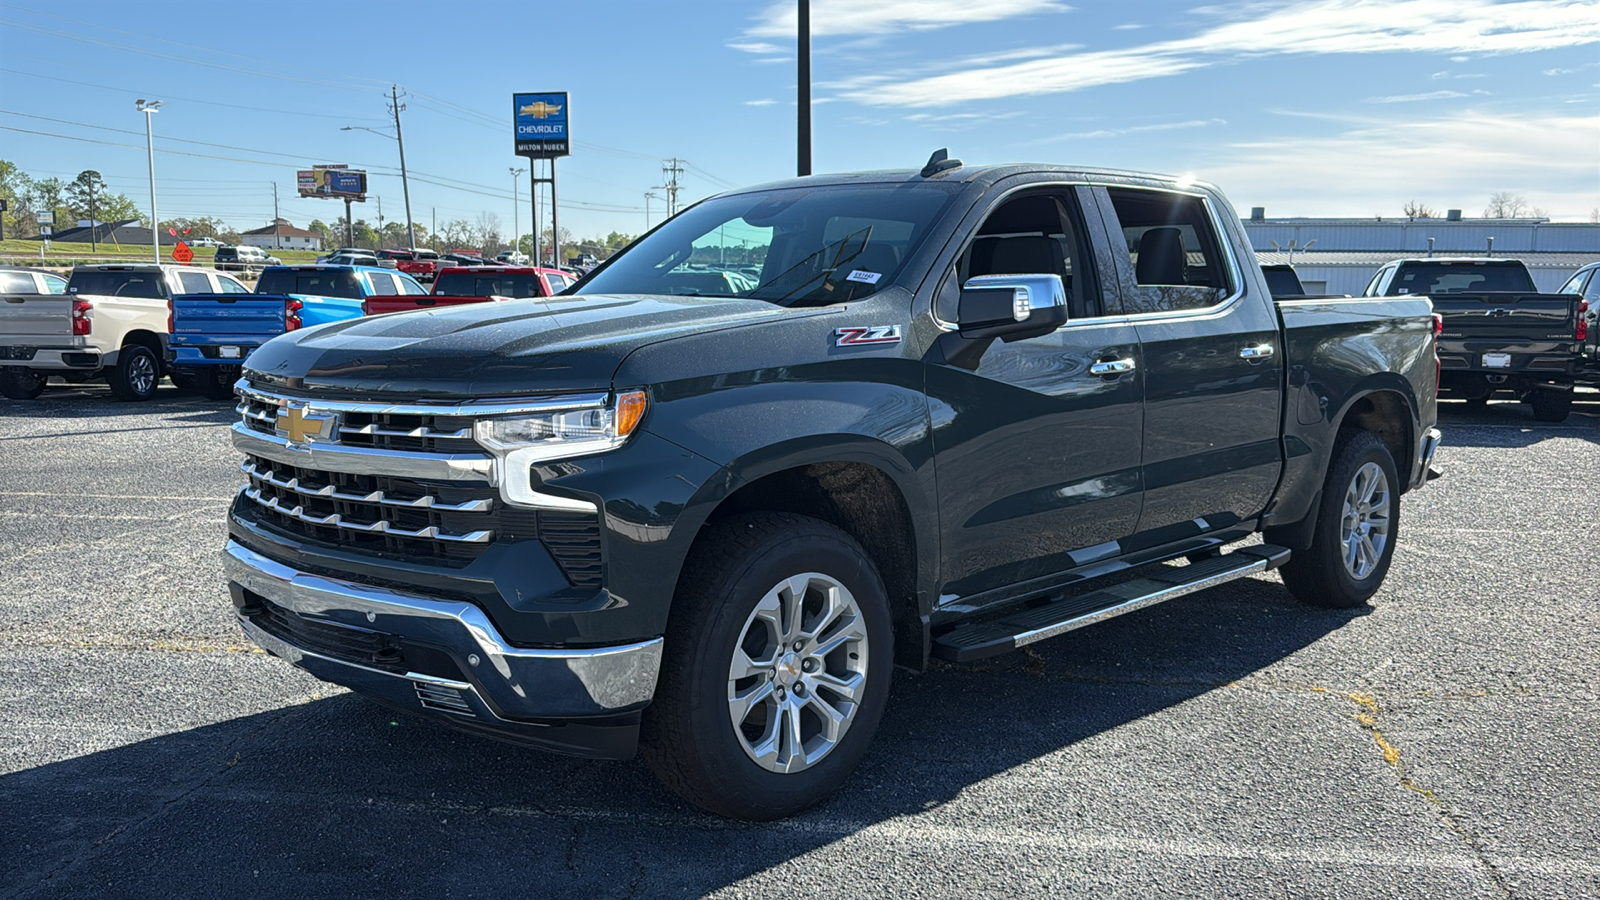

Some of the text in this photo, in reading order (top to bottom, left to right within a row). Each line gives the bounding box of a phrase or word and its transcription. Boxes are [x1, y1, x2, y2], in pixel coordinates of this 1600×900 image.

[518, 125, 563, 134] CHEVROLET
[543, 143, 565, 151] RUBEN
[835, 324, 902, 347] Z71
